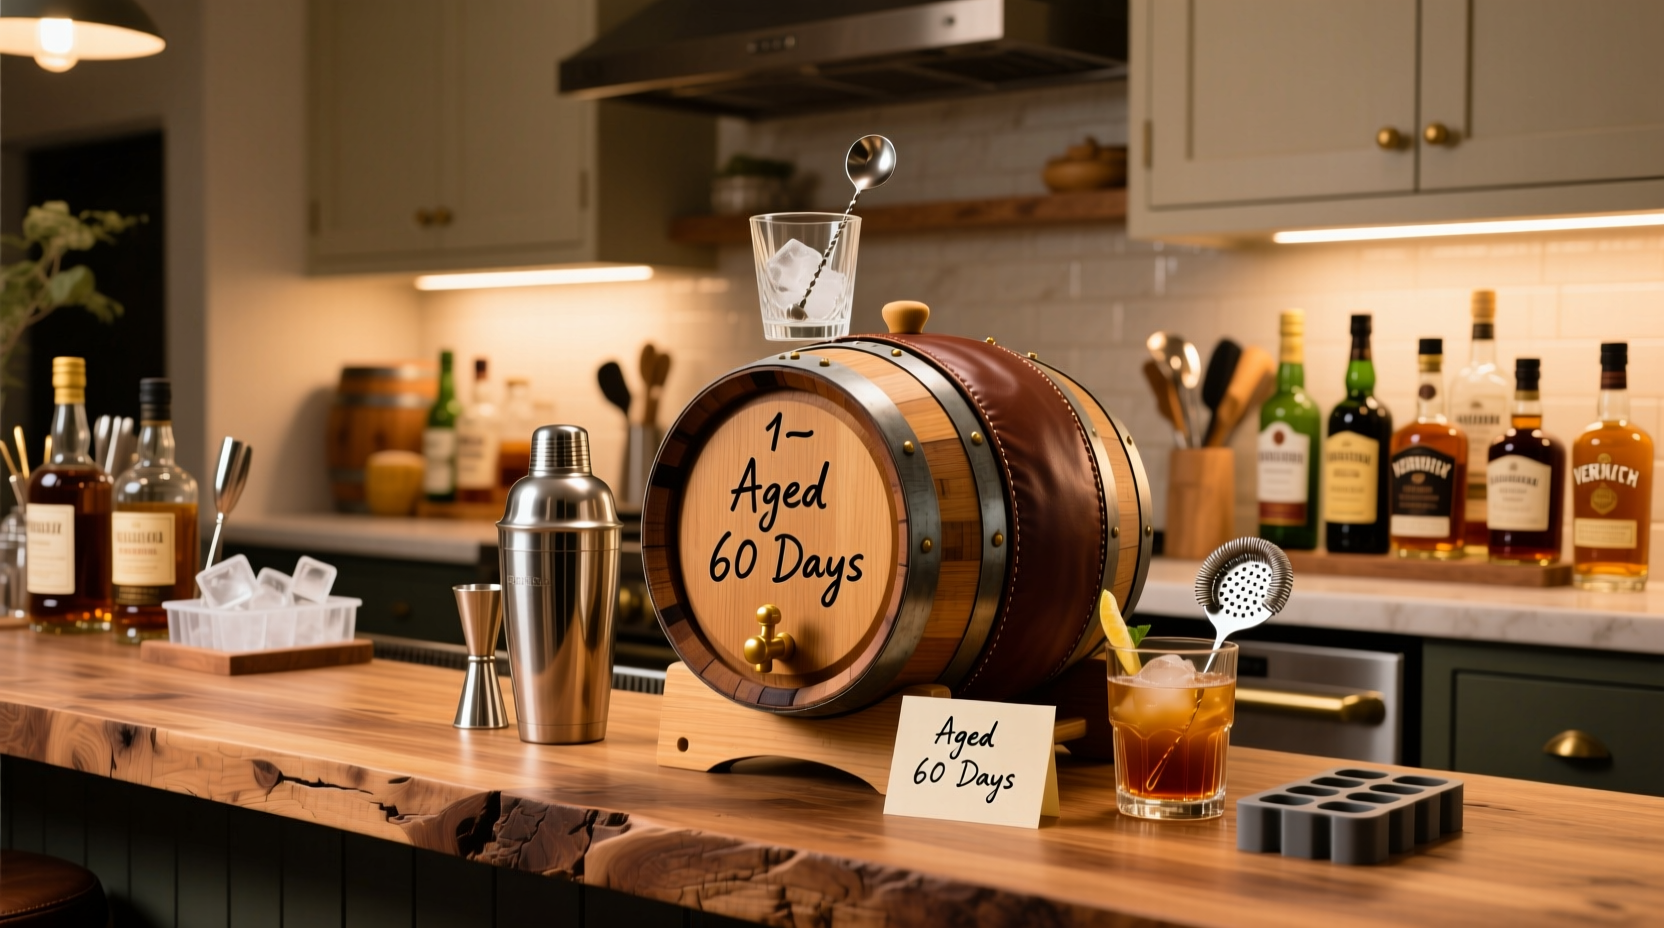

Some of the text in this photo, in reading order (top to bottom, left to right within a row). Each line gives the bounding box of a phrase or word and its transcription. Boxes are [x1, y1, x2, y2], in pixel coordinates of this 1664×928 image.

[730, 457, 830, 533] Aged
[709, 530, 864, 608] 60 Days
[934, 715, 999, 760] Aged
[913, 757, 1016, 804] 60 Days
